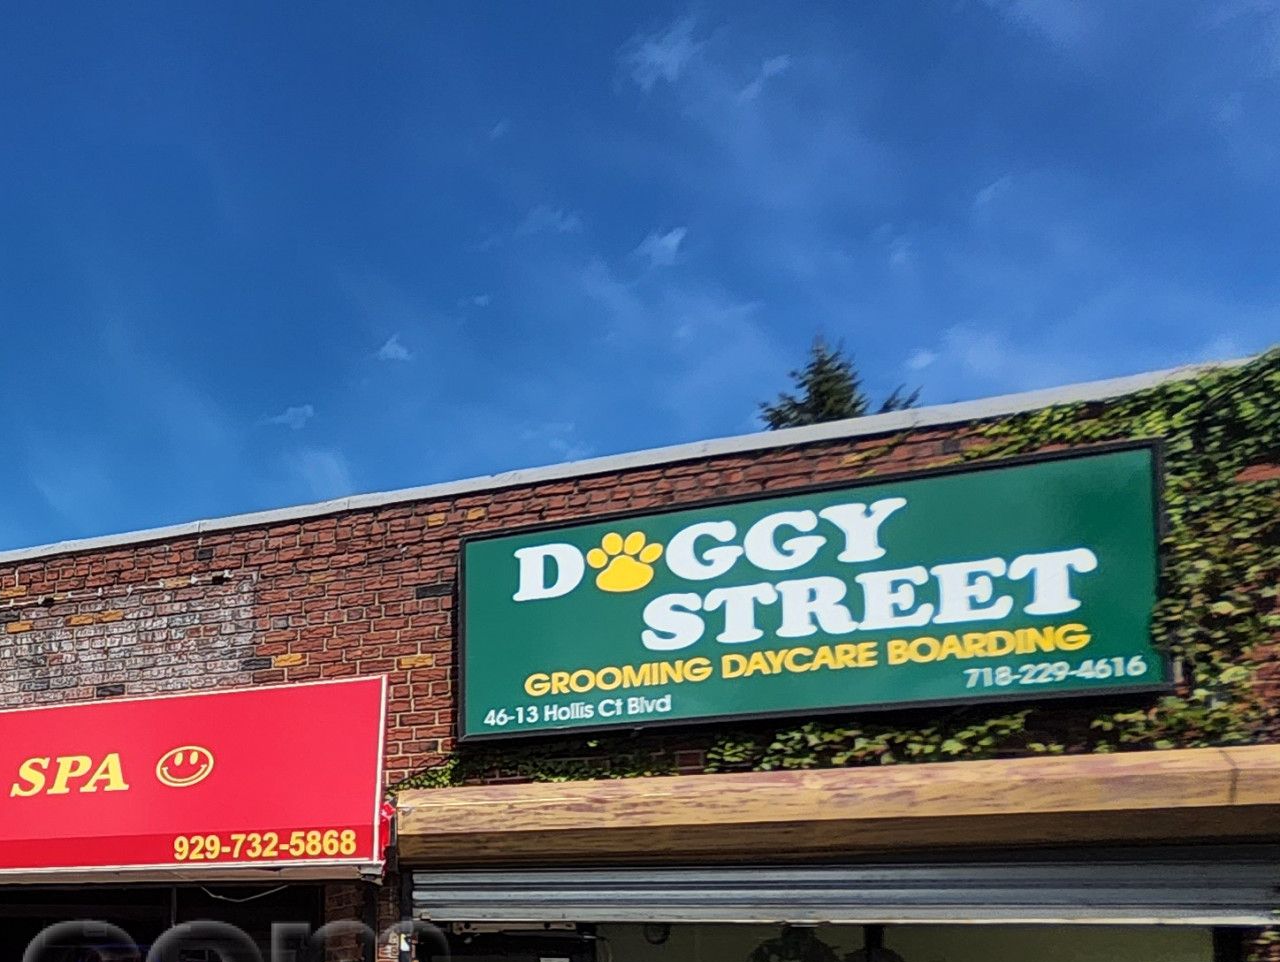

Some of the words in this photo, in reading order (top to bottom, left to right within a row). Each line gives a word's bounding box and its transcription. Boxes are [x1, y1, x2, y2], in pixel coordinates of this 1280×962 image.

[641, 547, 1098, 651] STREET
[524, 656, 714, 698] GROOMING
[720, 642, 879, 682] DAYCARE
[885, 623, 1093, 666] BOARDING
[963, 655, 1148, 690] 718-229-4616
[483, 706, 539, 726] 46-13
[543, 702, 595, 723] Hollis
[597, 698, 623, 718] Ct
[626, 694, 672, 716] Blvd
[9, 752, 130, 798] SPA
[173, 828, 358, 862] 929-732-5868
